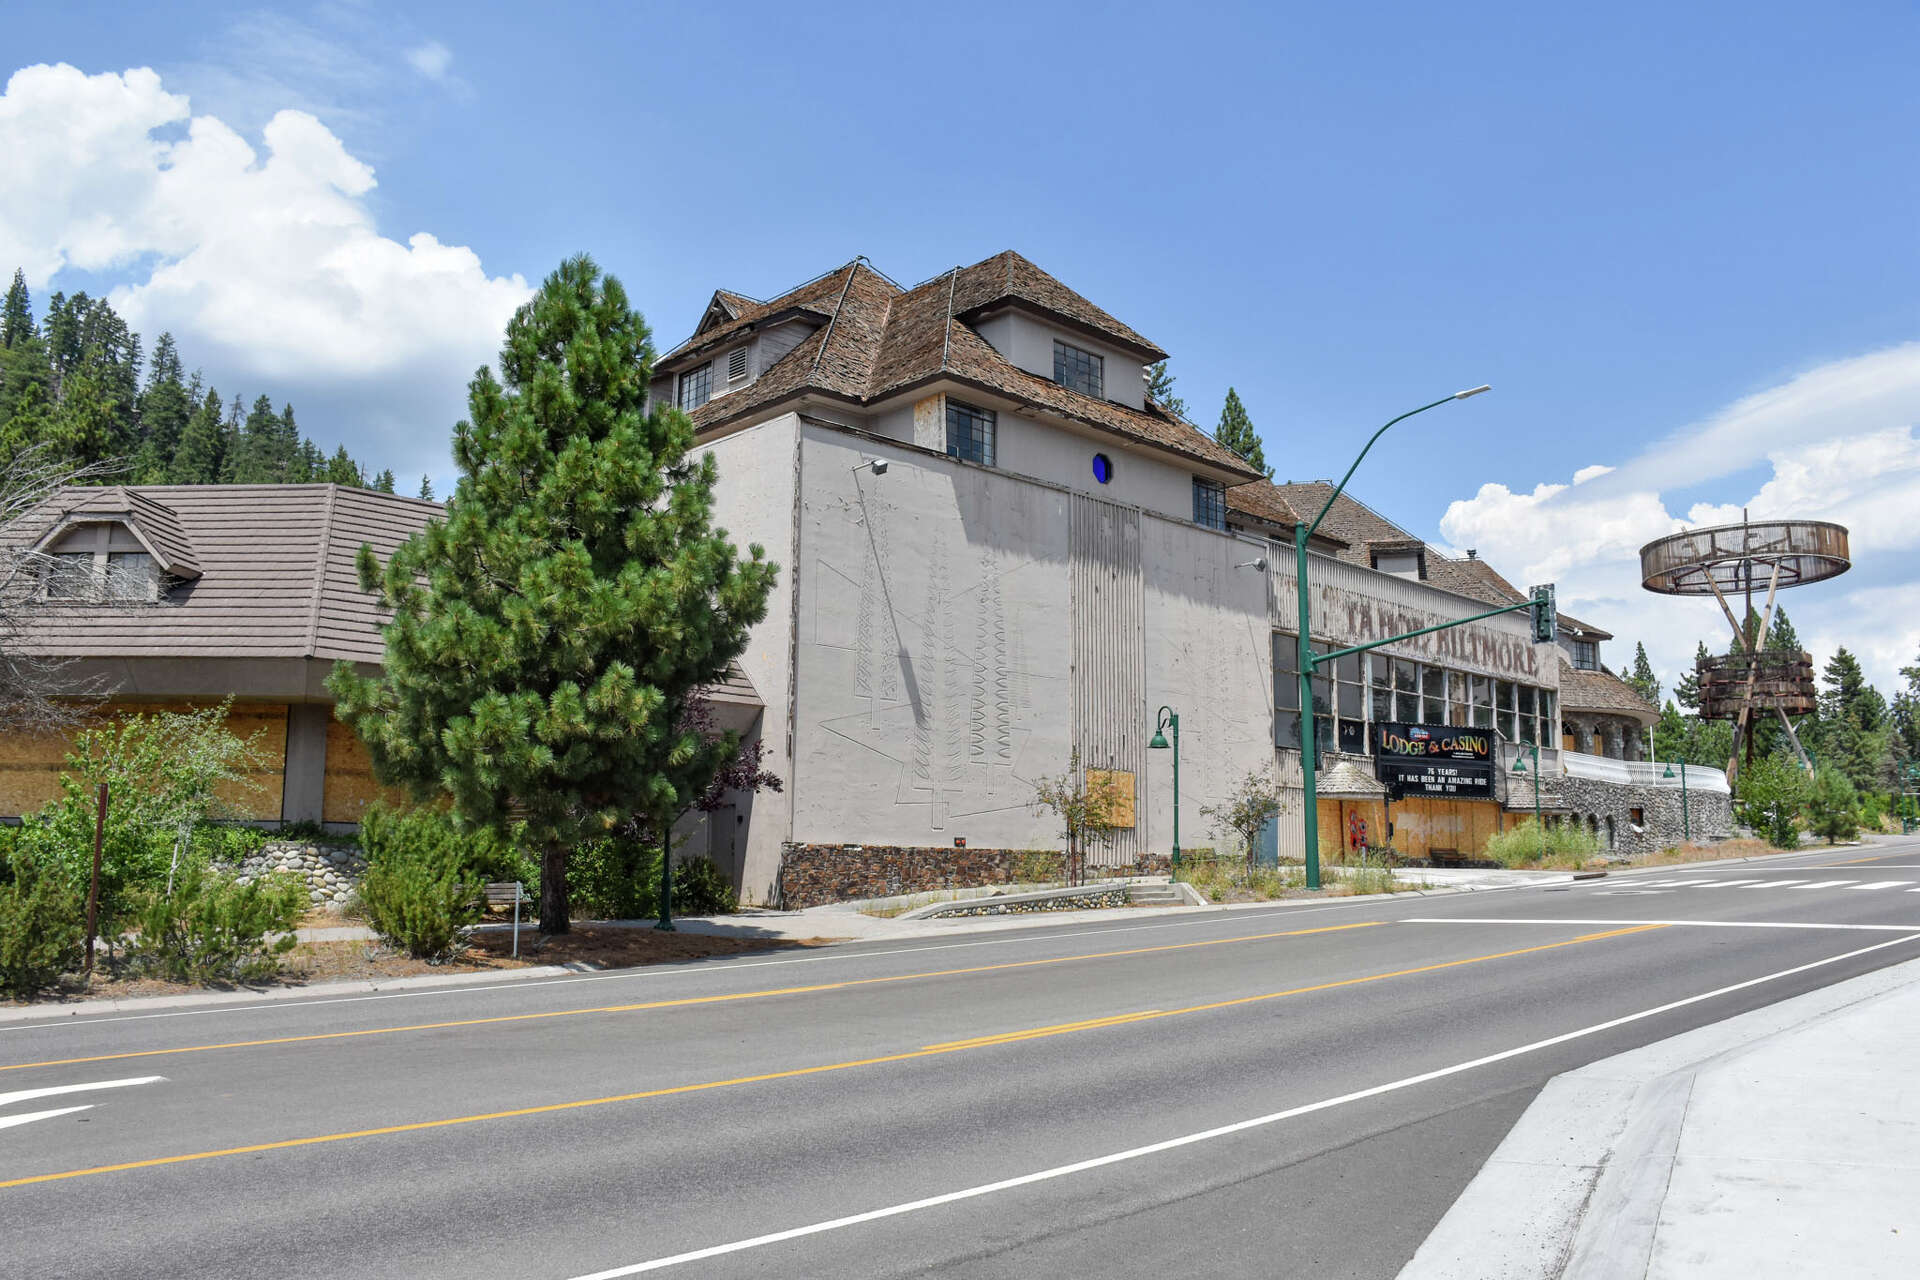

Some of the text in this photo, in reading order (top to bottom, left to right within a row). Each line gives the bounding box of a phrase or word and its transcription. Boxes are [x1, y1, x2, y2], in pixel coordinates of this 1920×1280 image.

[1382, 729, 1426, 755] LODGE
[1429, 740, 1440, 755] &
[1441, 735, 1488, 755] CASINO
[1406, 775, 1418, 783] HAS
[1437, 776, 1446, 784] AN
[1447, 776, 1472, 785] AMAZING
[1474, 778, 1487, 786] RIDE
[1425, 784, 1443, 792] THANK
